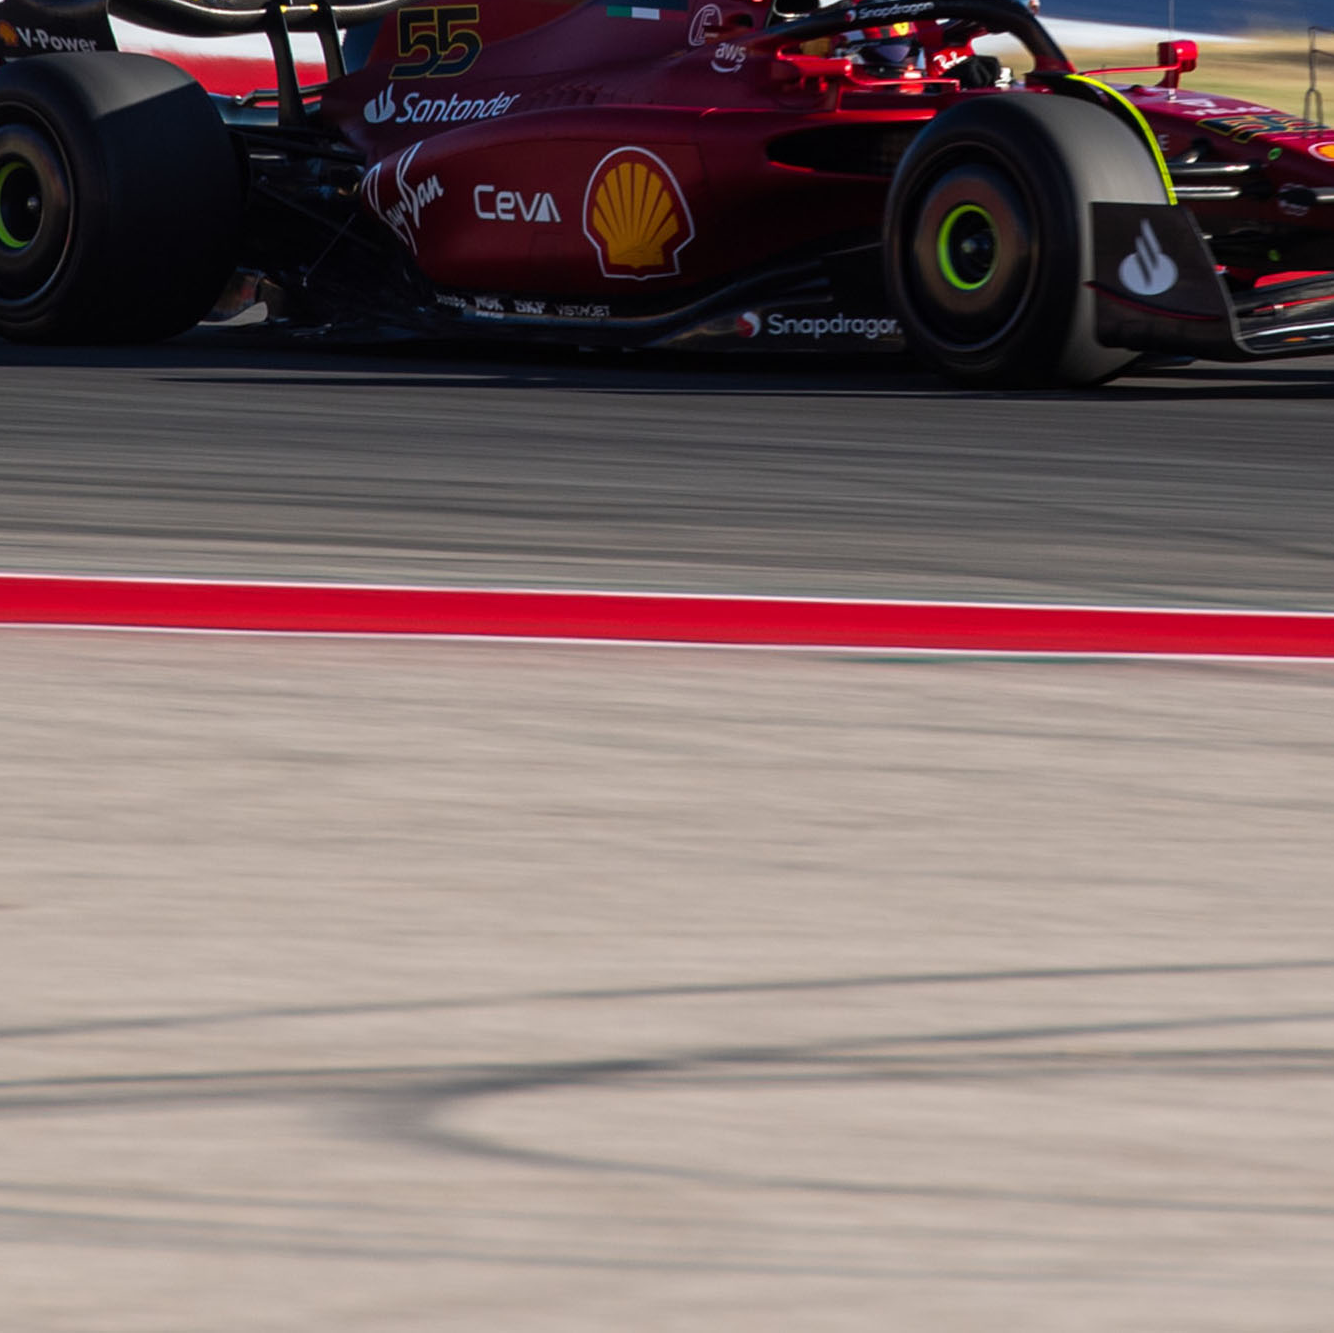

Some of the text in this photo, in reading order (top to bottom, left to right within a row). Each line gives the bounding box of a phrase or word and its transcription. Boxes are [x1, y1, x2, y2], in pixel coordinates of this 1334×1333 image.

[858, 1, 935, 20] Snapdragon
[16, 27, 97, 52] V-Power
[389, 4, 483, 80] 55
[715, 42, 747, 63] aws
[395, 91, 522, 123] Santander
